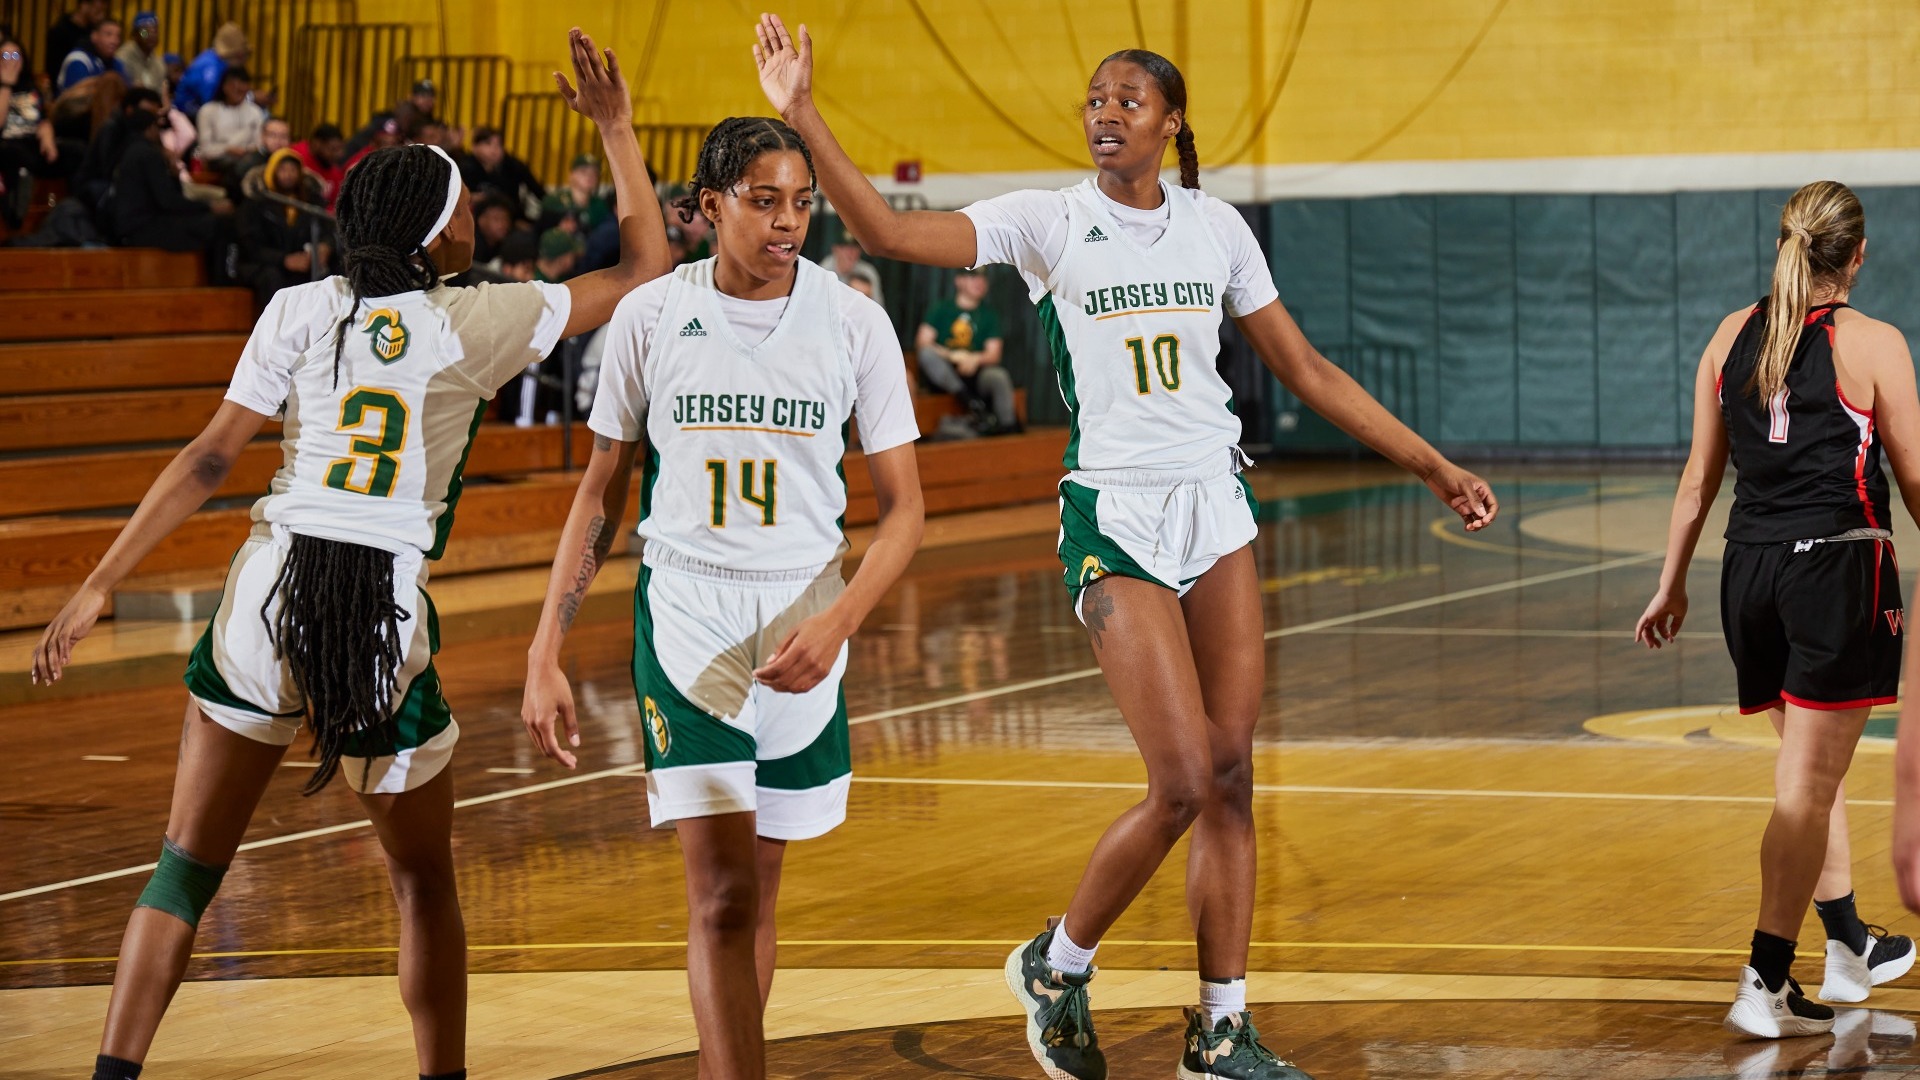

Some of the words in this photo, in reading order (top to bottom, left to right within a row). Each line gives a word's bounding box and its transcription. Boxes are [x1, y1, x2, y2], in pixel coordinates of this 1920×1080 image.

[1084, 235, 1109, 243] adidas
[1084, 282, 1169, 316] JERSEY
[1173, 282, 1215, 307] CITY
[1125, 333, 1181, 396] 10
[321, 384, 411, 498] 3
[673, 394, 765, 424] JERSEY
[772, 397, 825, 430] CITY
[1768, 382, 1791, 444] 1
[705, 459, 777, 528] 14
